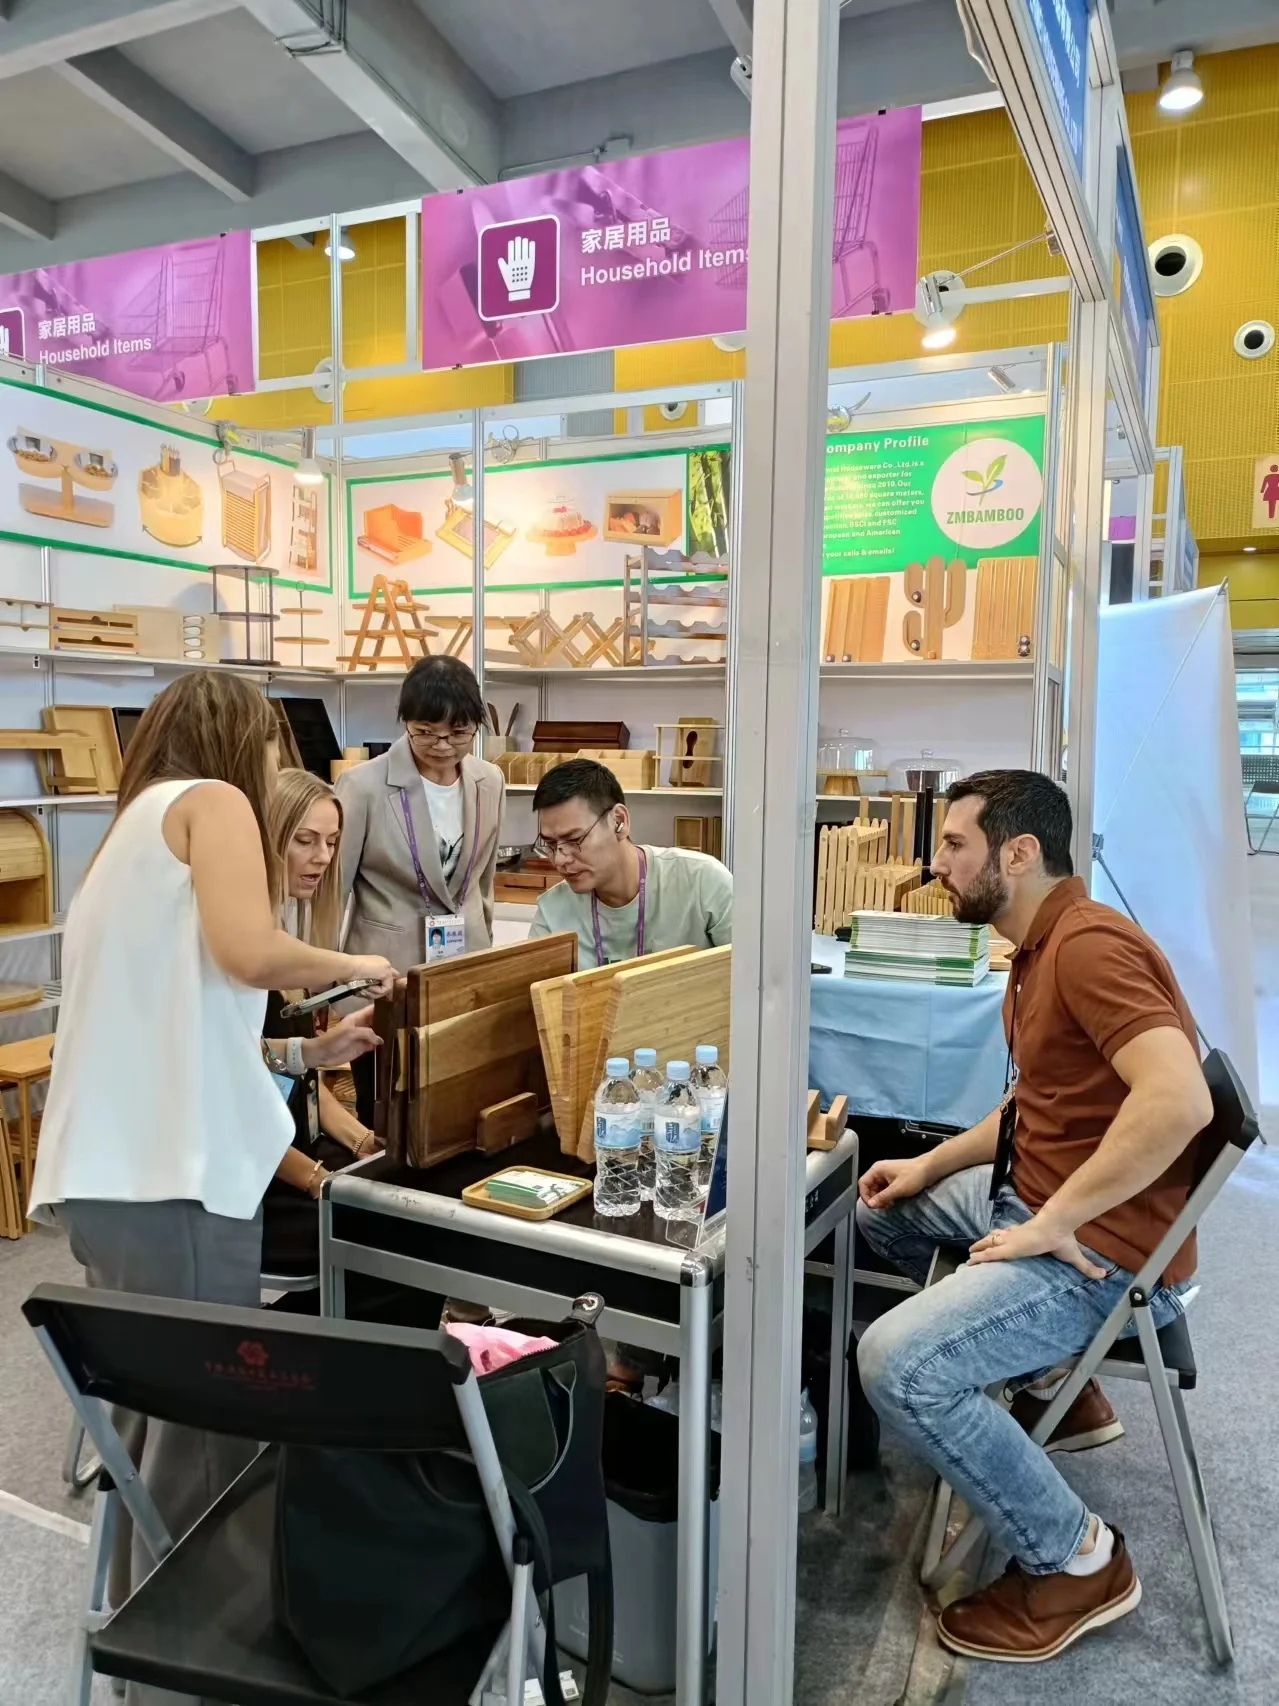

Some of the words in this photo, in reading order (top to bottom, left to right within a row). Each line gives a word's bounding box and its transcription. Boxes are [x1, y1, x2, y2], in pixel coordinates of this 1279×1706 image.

[581, 217, 671, 254] 家居用品
[580, 251, 692, 286] Household
[38, 312, 96, 340] 家居用品
[39, 339, 110, 365] Household
[113, 337, 152, 355] Items
[826, 440, 881, 455] ompany
[883, 435, 930, 449] Profile
[868, 472, 900, 480] exporter
[901, 470, 912, 478] for
[911, 499, 925, 507] you
[874, 508, 918, 517] customized
[946, 507, 1025, 525] ZMBAMBOO
[866, 528, 901, 537] American
[825, 550, 841, 560] your
